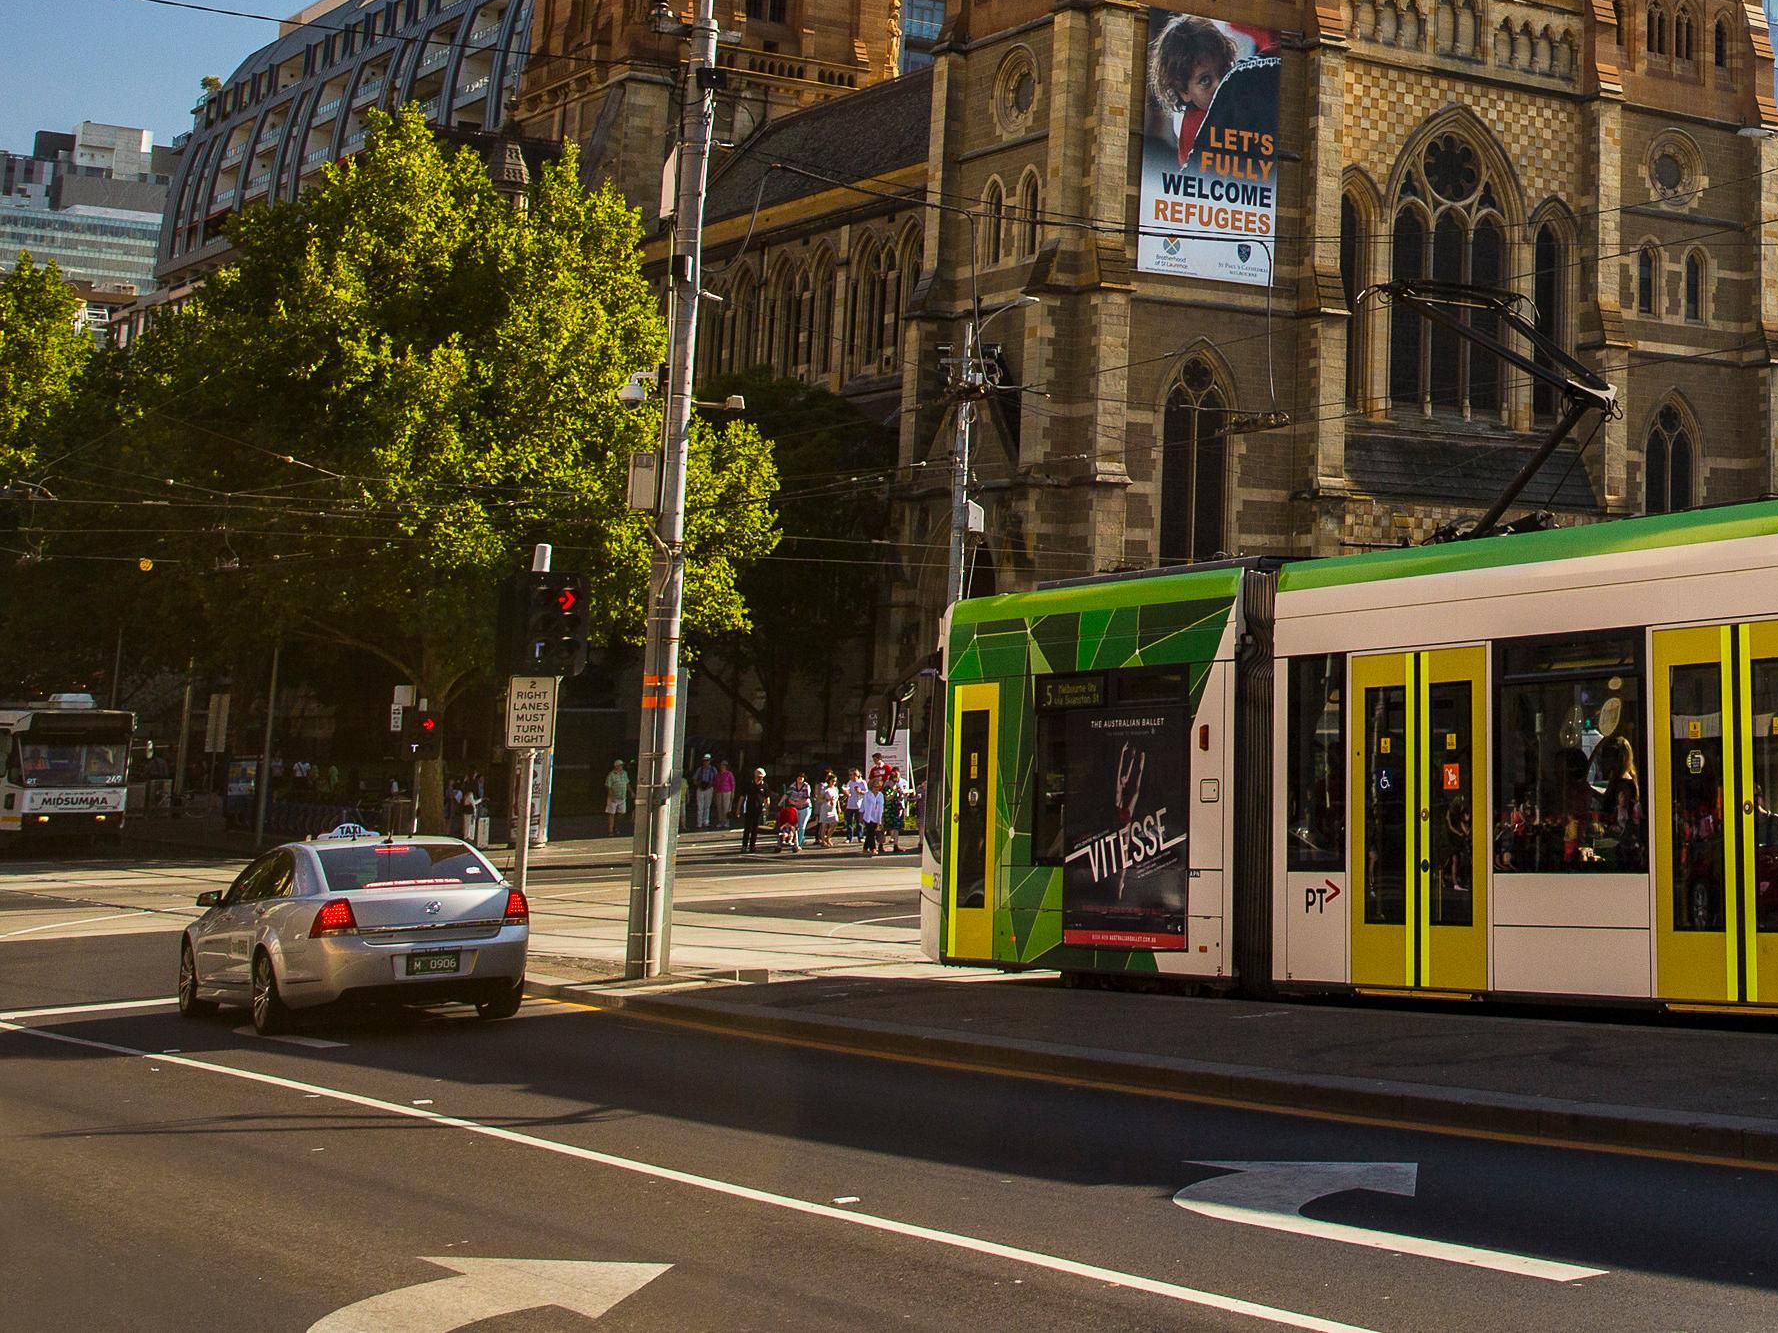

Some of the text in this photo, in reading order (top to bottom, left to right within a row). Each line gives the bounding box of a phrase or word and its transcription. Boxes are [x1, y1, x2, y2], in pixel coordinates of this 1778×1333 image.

[1210, 126, 1274, 156] LET'S
[1201, 151, 1273, 184] FULLY
[1162, 172, 1271, 208] WELCOME
[1154, 199, 1271, 235] REFUGEES
[1155, 253, 1187, 264] Brotherhood
[529, 680, 537, 689] 2
[516, 691, 548, 700] RIGHT
[1046, 685, 1053, 705] 5
[513, 702, 550, 711] LANES
[516, 713, 546, 722] MUST
[1091, 717, 1164, 728] THE AUSTRALIAN BALLET
[515, 724, 545, 733] TURN
[513, 735, 545, 744] RIGHT
[41, 796, 109, 806] MIDSUMMA
[339, 825, 362, 835] TAXI
[1065, 807, 1187, 883] VITESSE
[430, 958, 457, 970] 0906
